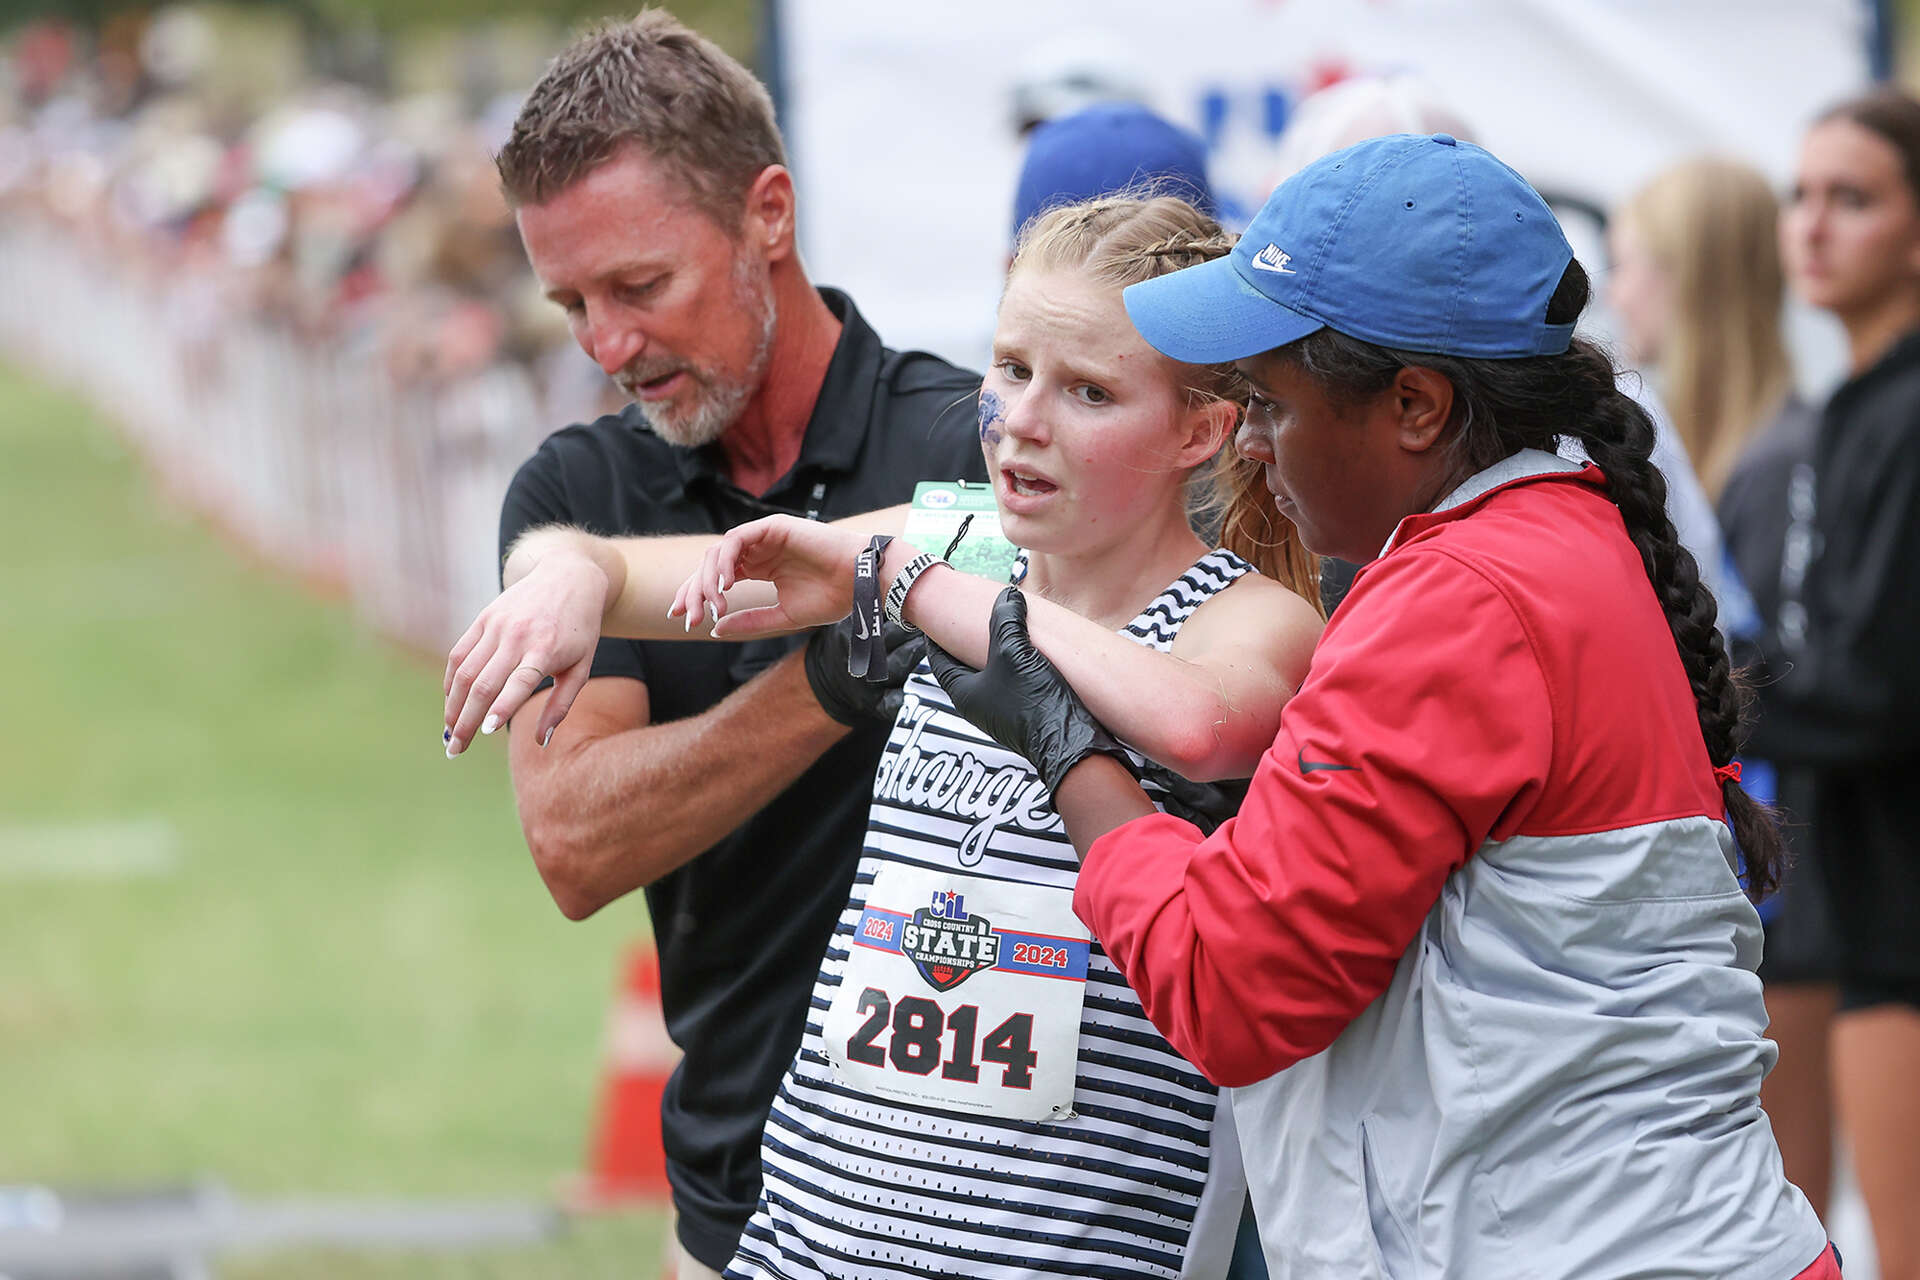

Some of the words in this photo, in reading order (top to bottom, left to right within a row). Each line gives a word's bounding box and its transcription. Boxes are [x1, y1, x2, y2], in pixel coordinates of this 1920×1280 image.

[1262, 242, 1292, 268] NIKE
[930, 890, 968, 920] UIL
[864, 917, 894, 942] 2024
[923, 918, 942, 929] CROSS
[943, 922, 975, 933] COUNTRY
[904, 924, 997, 962] STATE
[1013, 943, 1068, 968] 2024
[915, 952, 975, 968] CHAMPIONSHIPS
[847, 987, 1038, 1090] 2814
